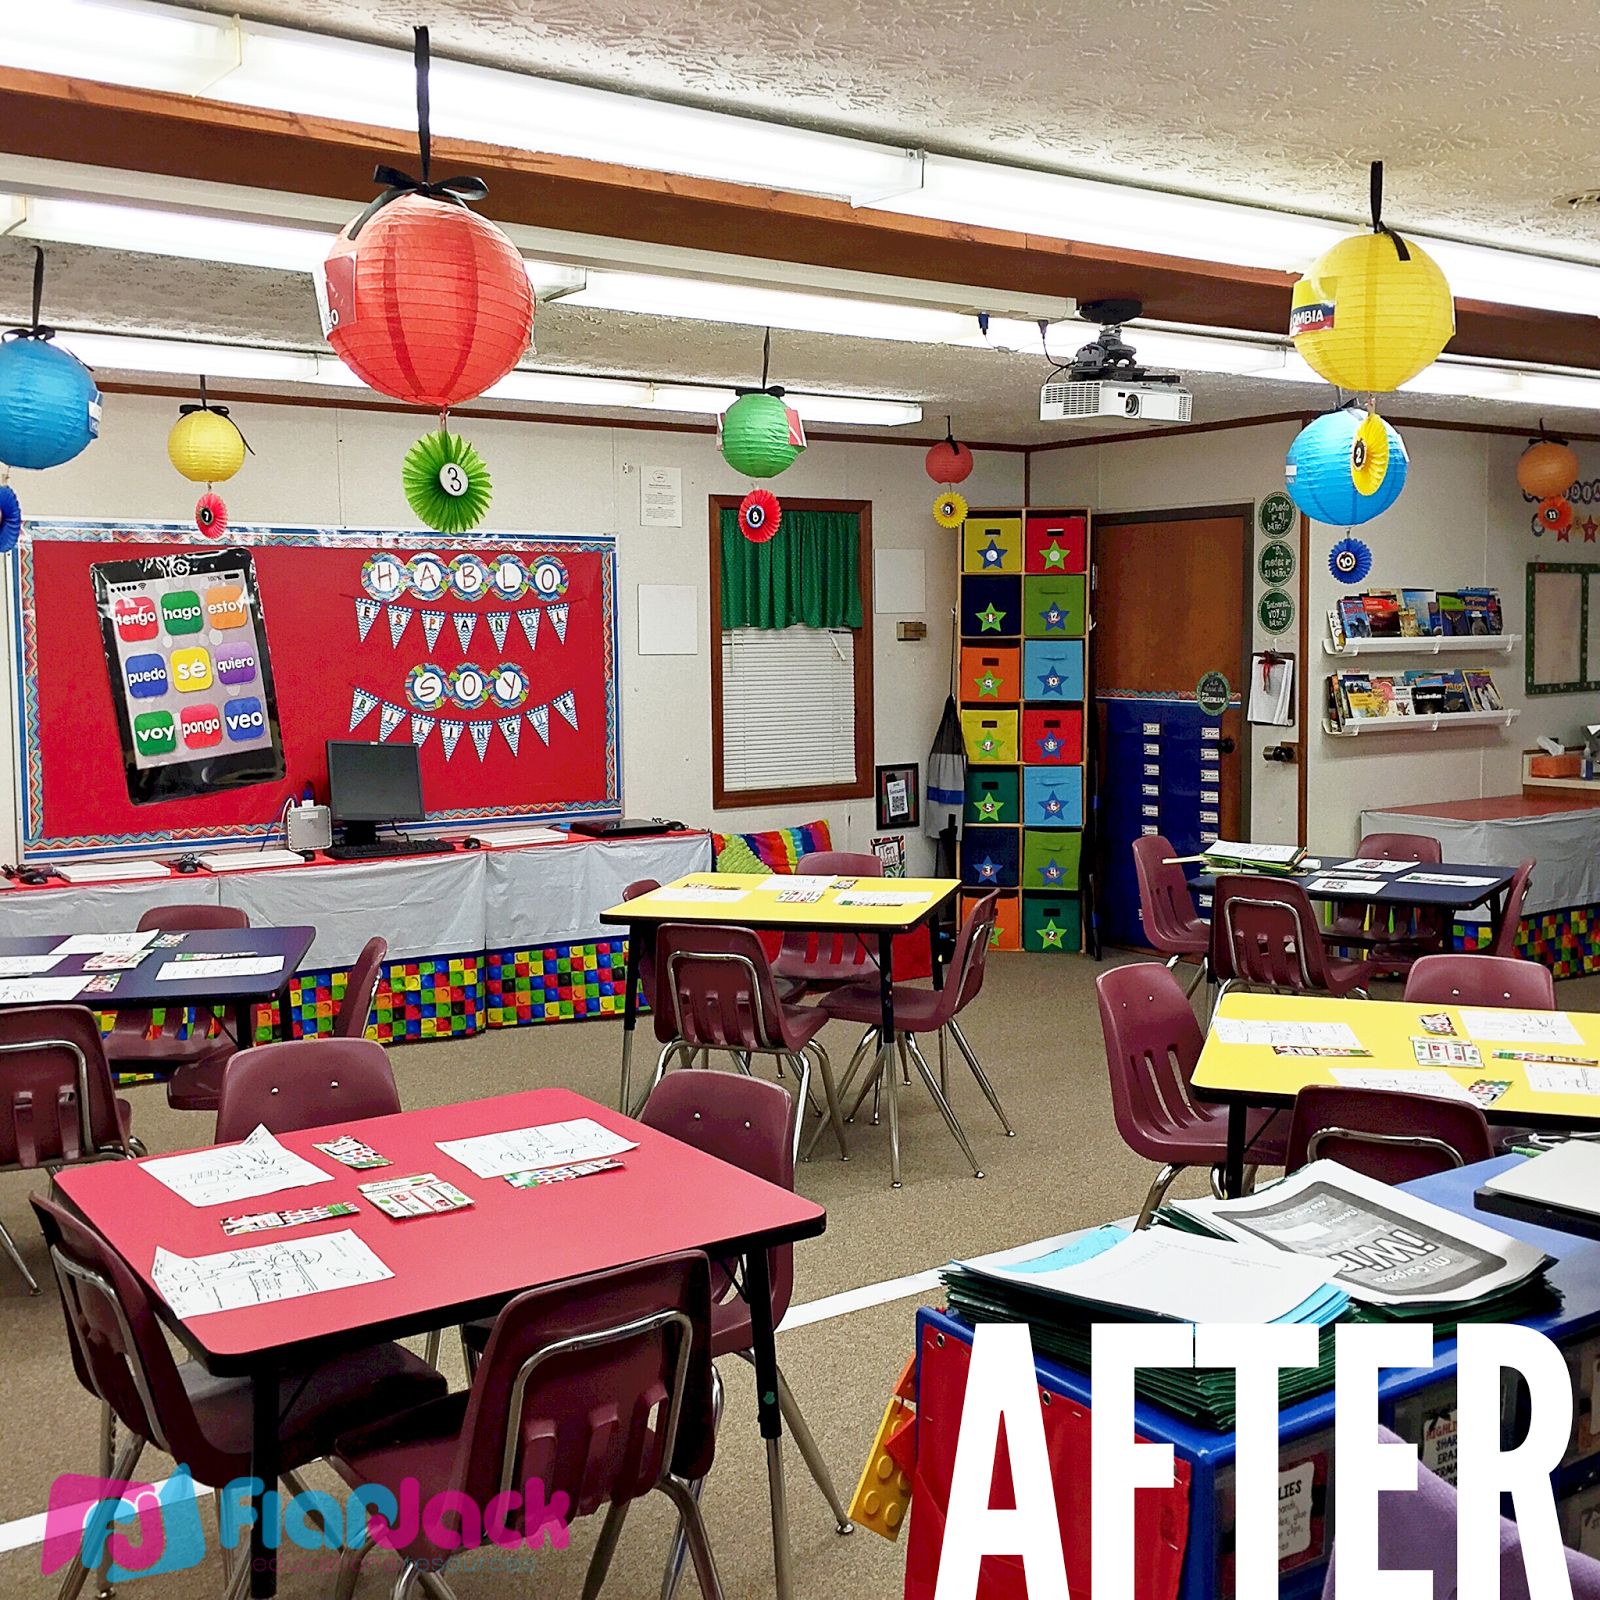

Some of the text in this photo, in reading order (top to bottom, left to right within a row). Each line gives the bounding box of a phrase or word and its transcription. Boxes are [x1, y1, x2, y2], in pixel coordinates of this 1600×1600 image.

[1355, 447, 1362, 464] 2
[448, 467, 462, 492] 3
[945, 505, 951, 514] 9
[1548, 511, 1557, 519] 11
[204, 511, 209, 521] 7
[752, 511, 760, 522] 8
[1340, 557, 1352, 568] 10
[377, 563, 555, 590] HABLO
[163, 605, 202, 621] hago
[207, 600, 244, 615] estoy
[116, 610, 157, 626] tengo
[1049, 612, 1058, 622] 12
[177, 657, 207, 681] sé
[217, 654, 254, 674] quiero
[128, 666, 166, 687] puedo
[420, 673, 516, 698] SOY
[985, 679, 992, 688] 9
[1048, 678, 1058, 687] 10
[225, 711, 263, 731] veo
[183, 717, 220, 737] pongo
[137, 725, 174, 745] voy
[985, 741, 990, 750] 7
[1048, 740, 1054, 750] 8
[986, 803, 992, 812] 5
[1051, 802, 1057, 811] 6
[985, 865, 990, 874] 3
[1050, 868, 1056, 877] 4
[1049, 931, 1054, 940] 2
